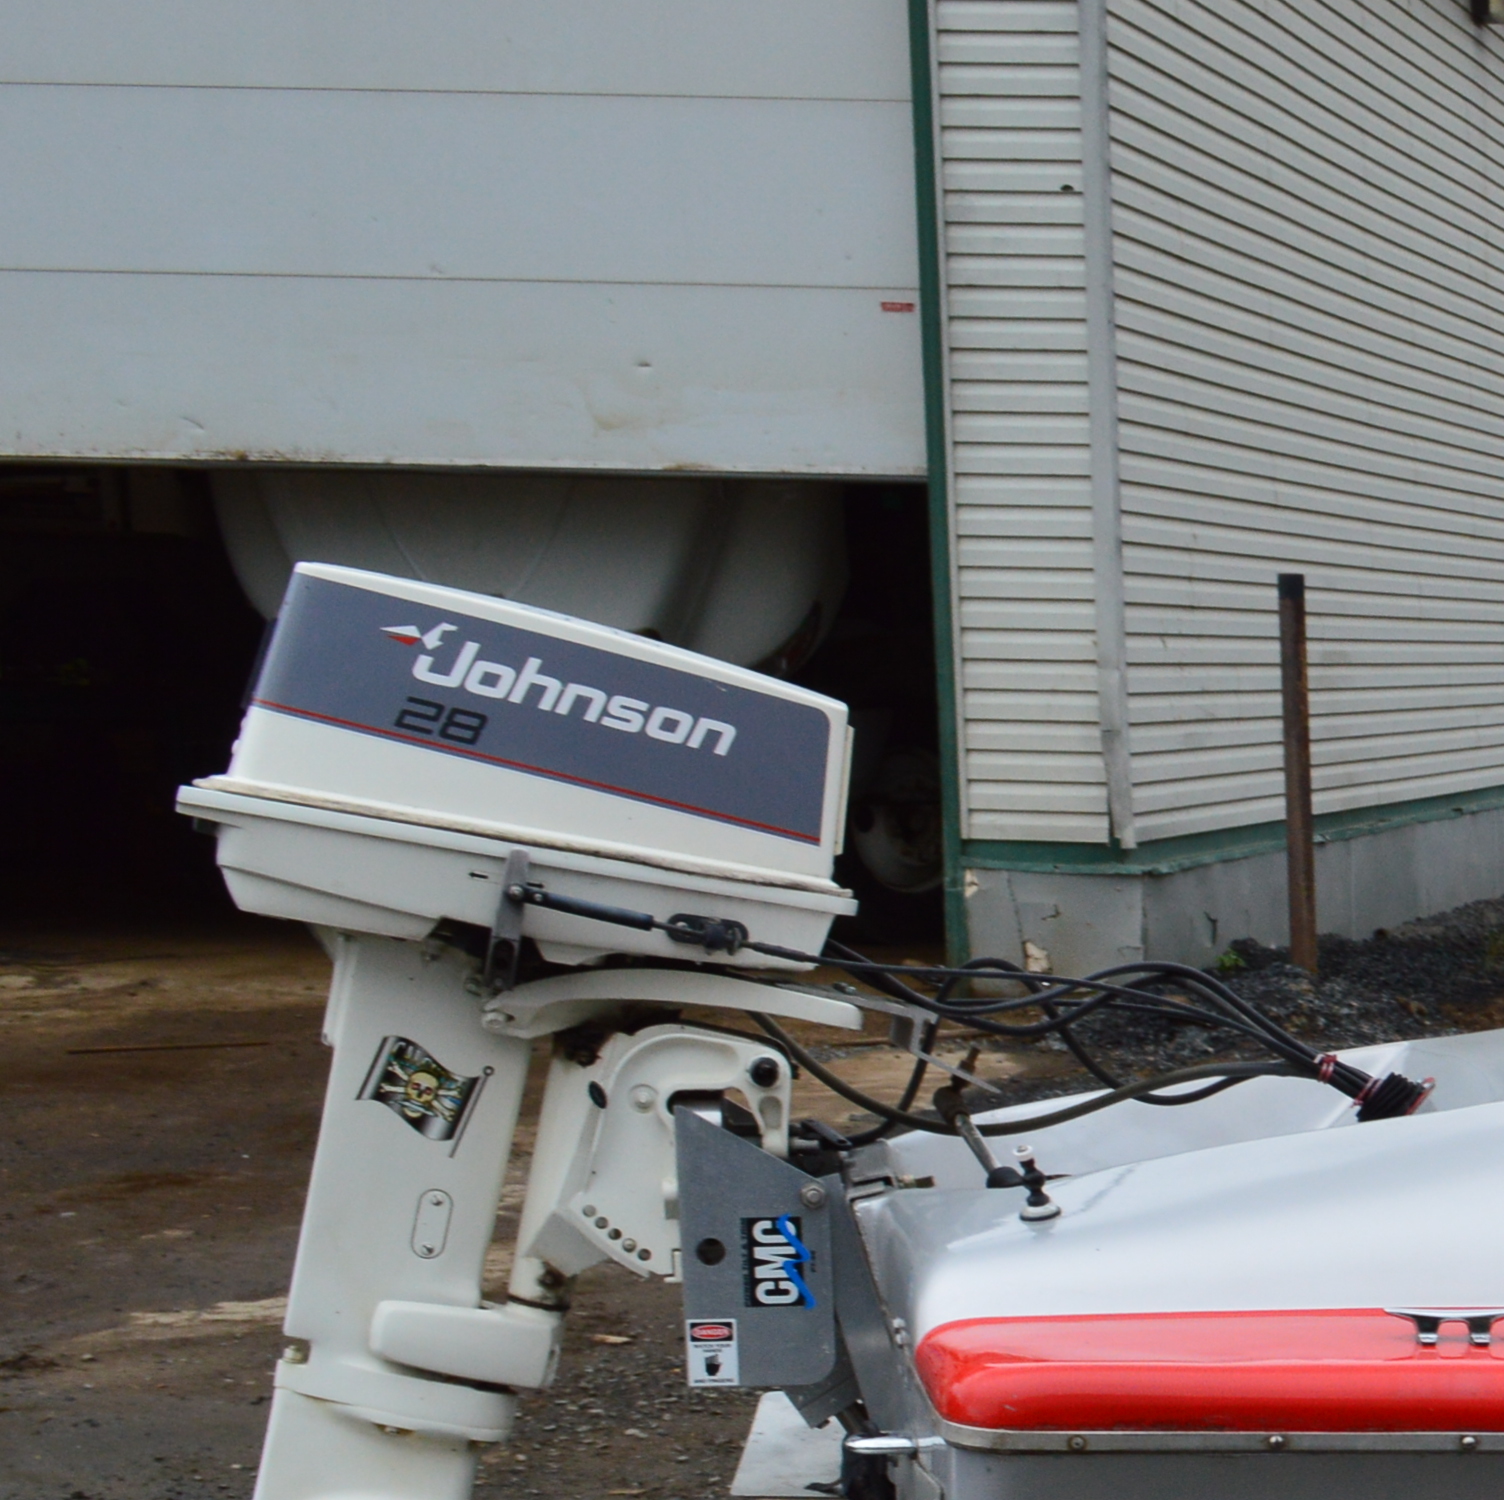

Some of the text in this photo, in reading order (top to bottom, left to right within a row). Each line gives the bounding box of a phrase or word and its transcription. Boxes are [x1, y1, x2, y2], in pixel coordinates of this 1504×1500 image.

[393, 695, 489, 746] 28
[411, 641, 738, 757] Johnson
[751, 1219, 800, 1305] CMC
